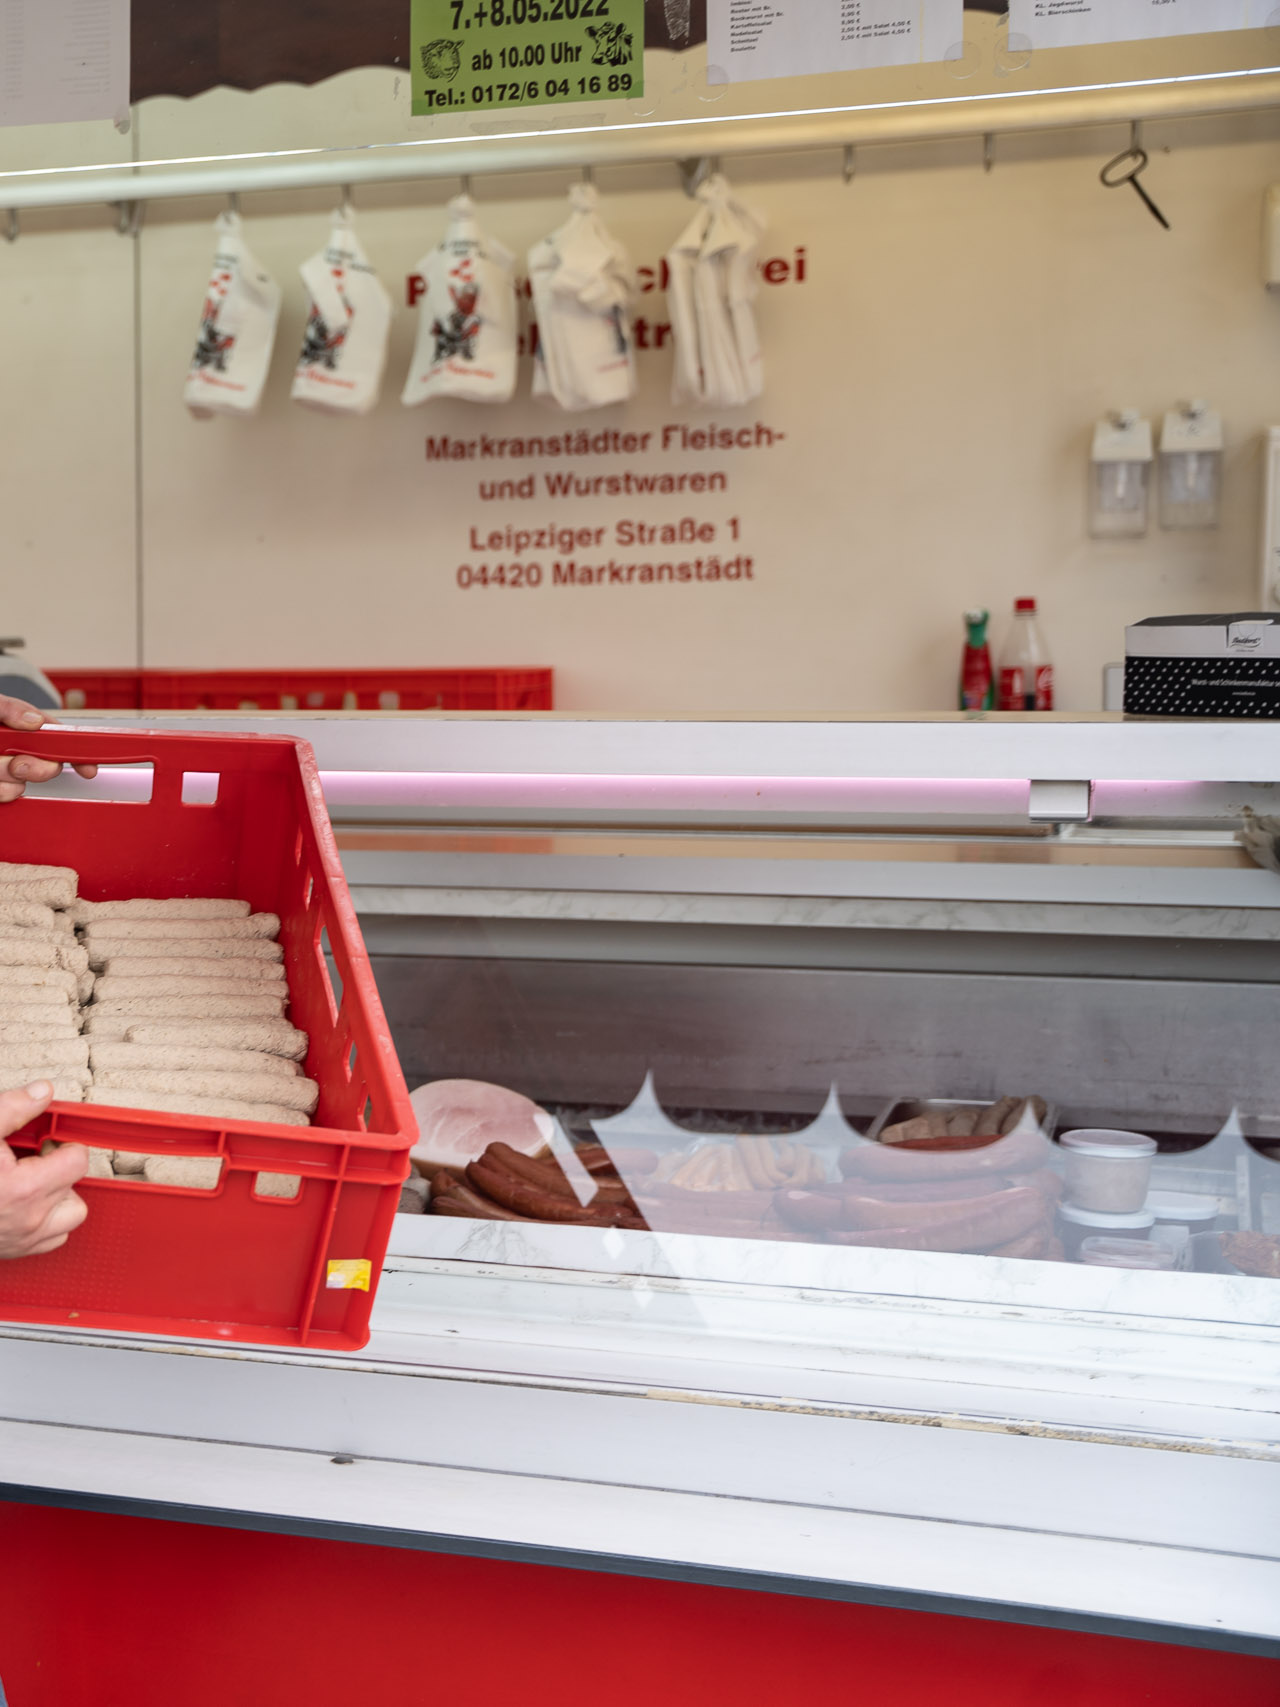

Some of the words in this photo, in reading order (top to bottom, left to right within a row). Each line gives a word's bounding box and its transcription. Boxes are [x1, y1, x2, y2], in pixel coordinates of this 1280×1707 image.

[450, 0, 610, 30] 7.+8.05.2022
[471, 49, 492, 71] ab
[499, 46, 545, 69] 10.00
[551, 41, 583, 63] Uhr
[424, 88, 465, 107] Tel.:
[472, 80, 539, 103] 0172/6
[545, 79, 570, 97] 04
[577, 76, 601, 95] 16
[607, 73, 633, 92] 89
[425, 428, 652, 462] Markranstädter
[661, 420, 786, 451] Fleisch-
[478, 473, 536, 501] und
[544, 470, 728, 498] Wurstwaren
[469, 523, 606, 557] Leipziger
[615, 516, 716, 547] Straße
[727, 514, 740, 542] 1
[456, 562, 543, 590] 04420
[551, 553, 755, 588] Markranstädt
